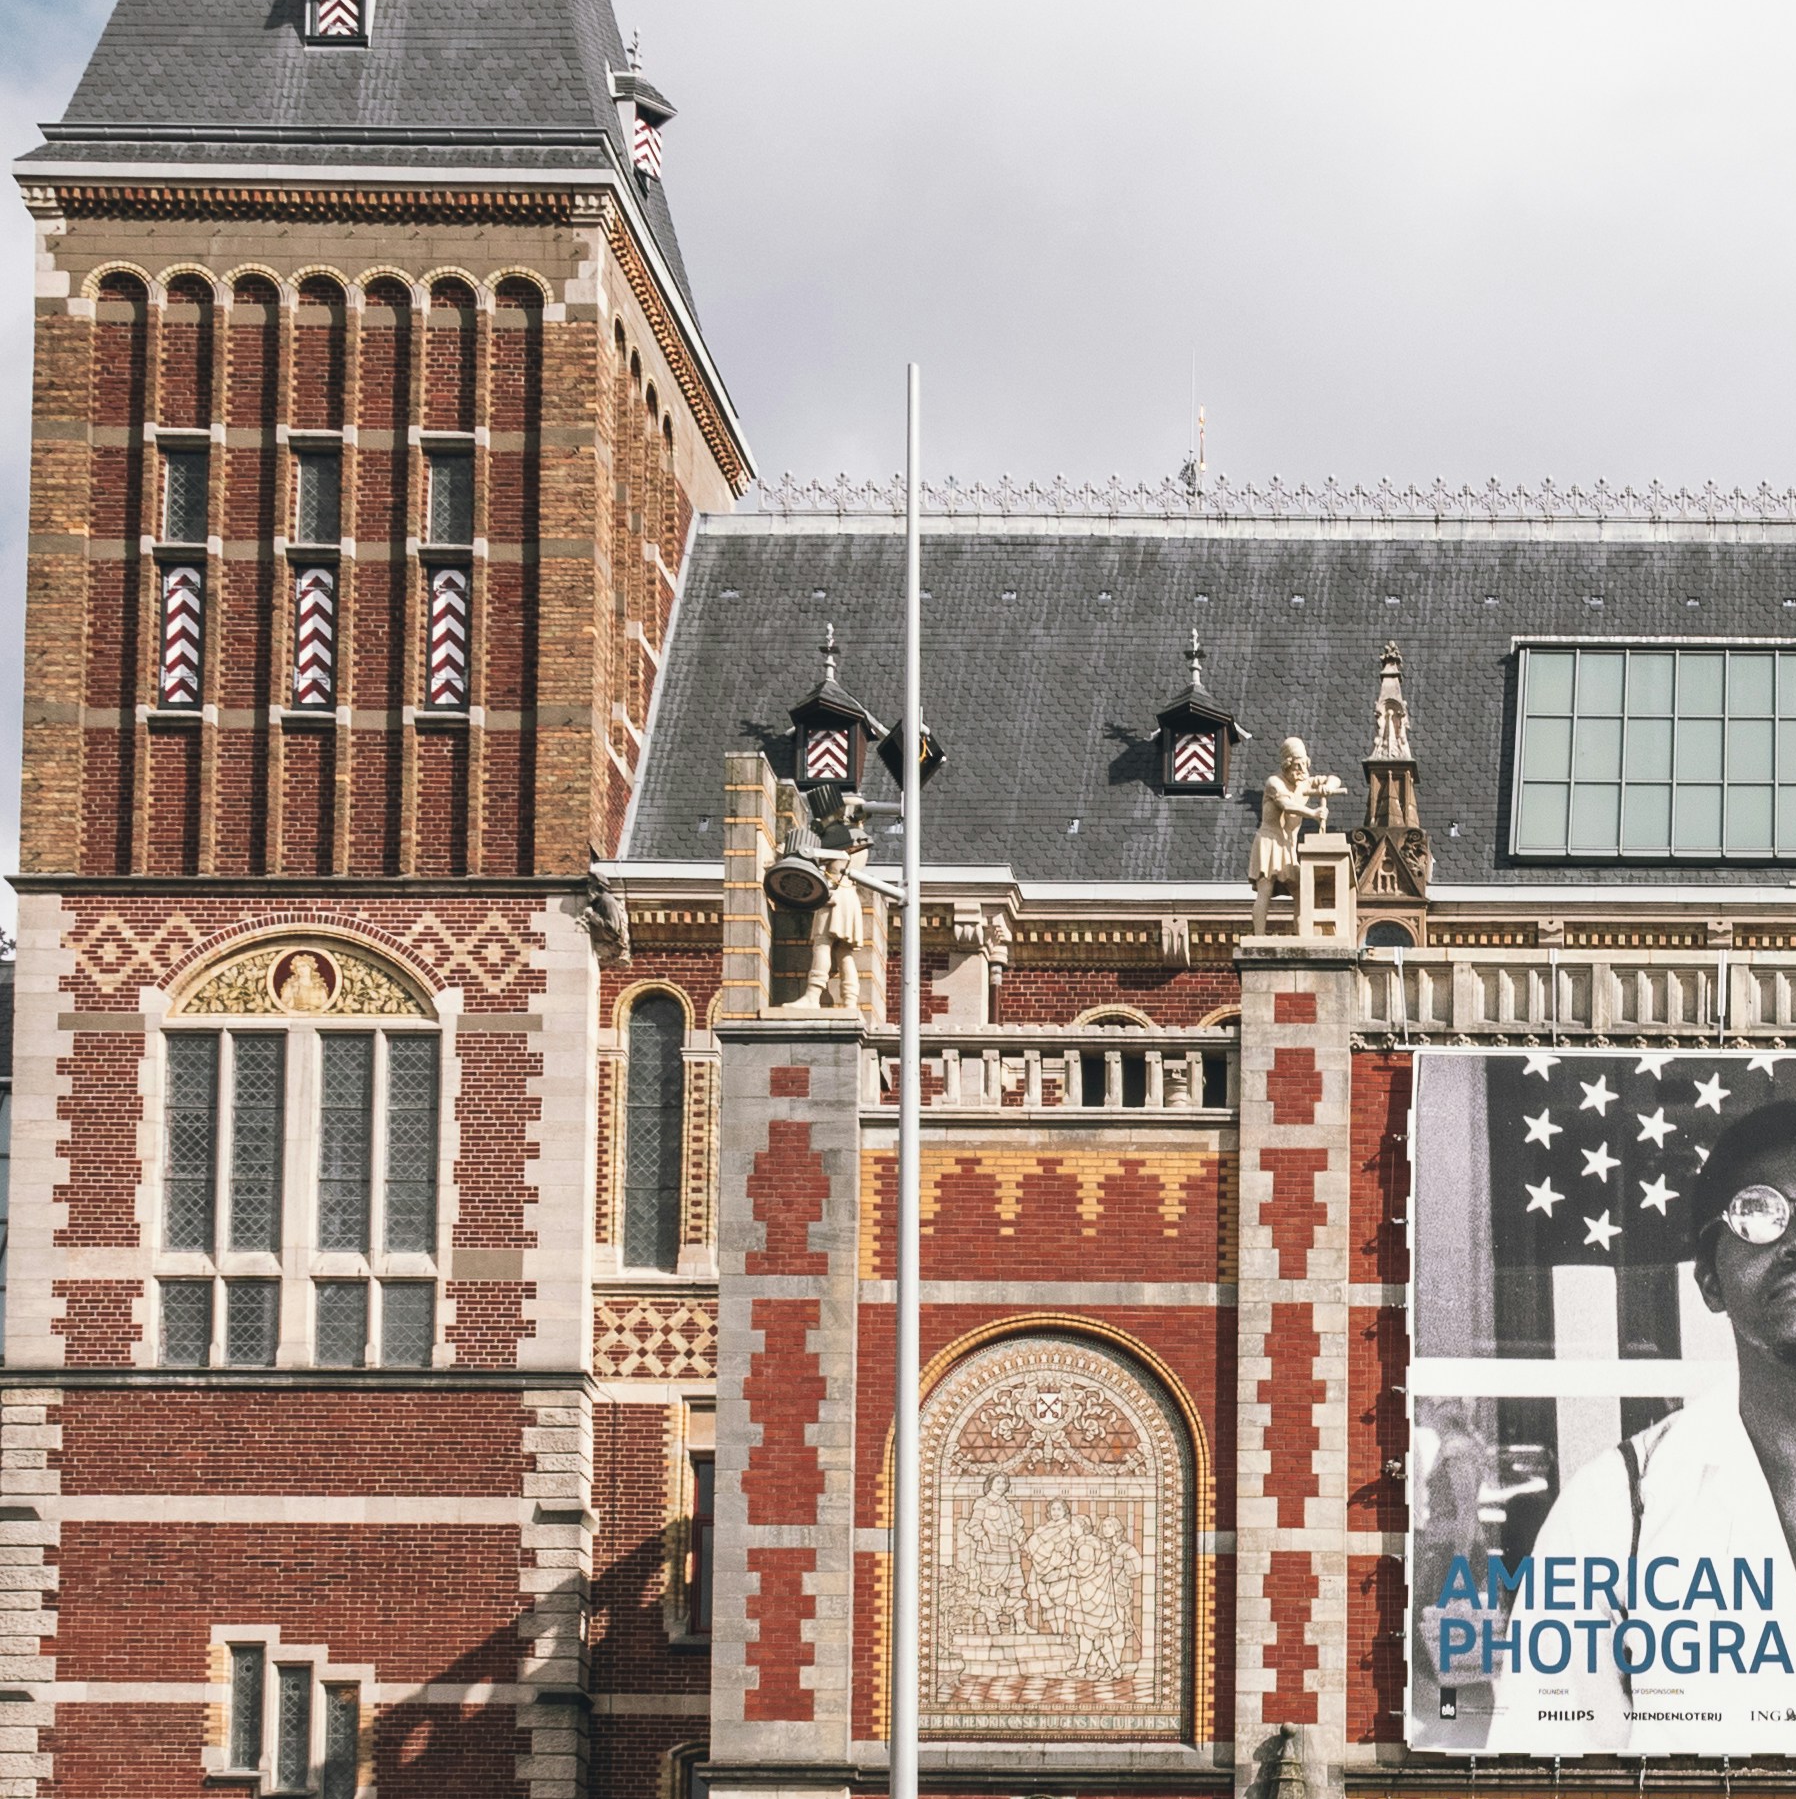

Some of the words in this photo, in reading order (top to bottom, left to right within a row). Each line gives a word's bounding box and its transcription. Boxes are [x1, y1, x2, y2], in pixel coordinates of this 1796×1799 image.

[1435, 1555, 1774, 1611] AMERICAN
[1538, 1688, 1569, 1696] FOUNDER
[1538, 1709, 1595, 1722] PHILIPS
[1623, 1711, 1722, 1722] VRIENDENLOTERIJ
[1750, 1710, 1781, 1721] ING
